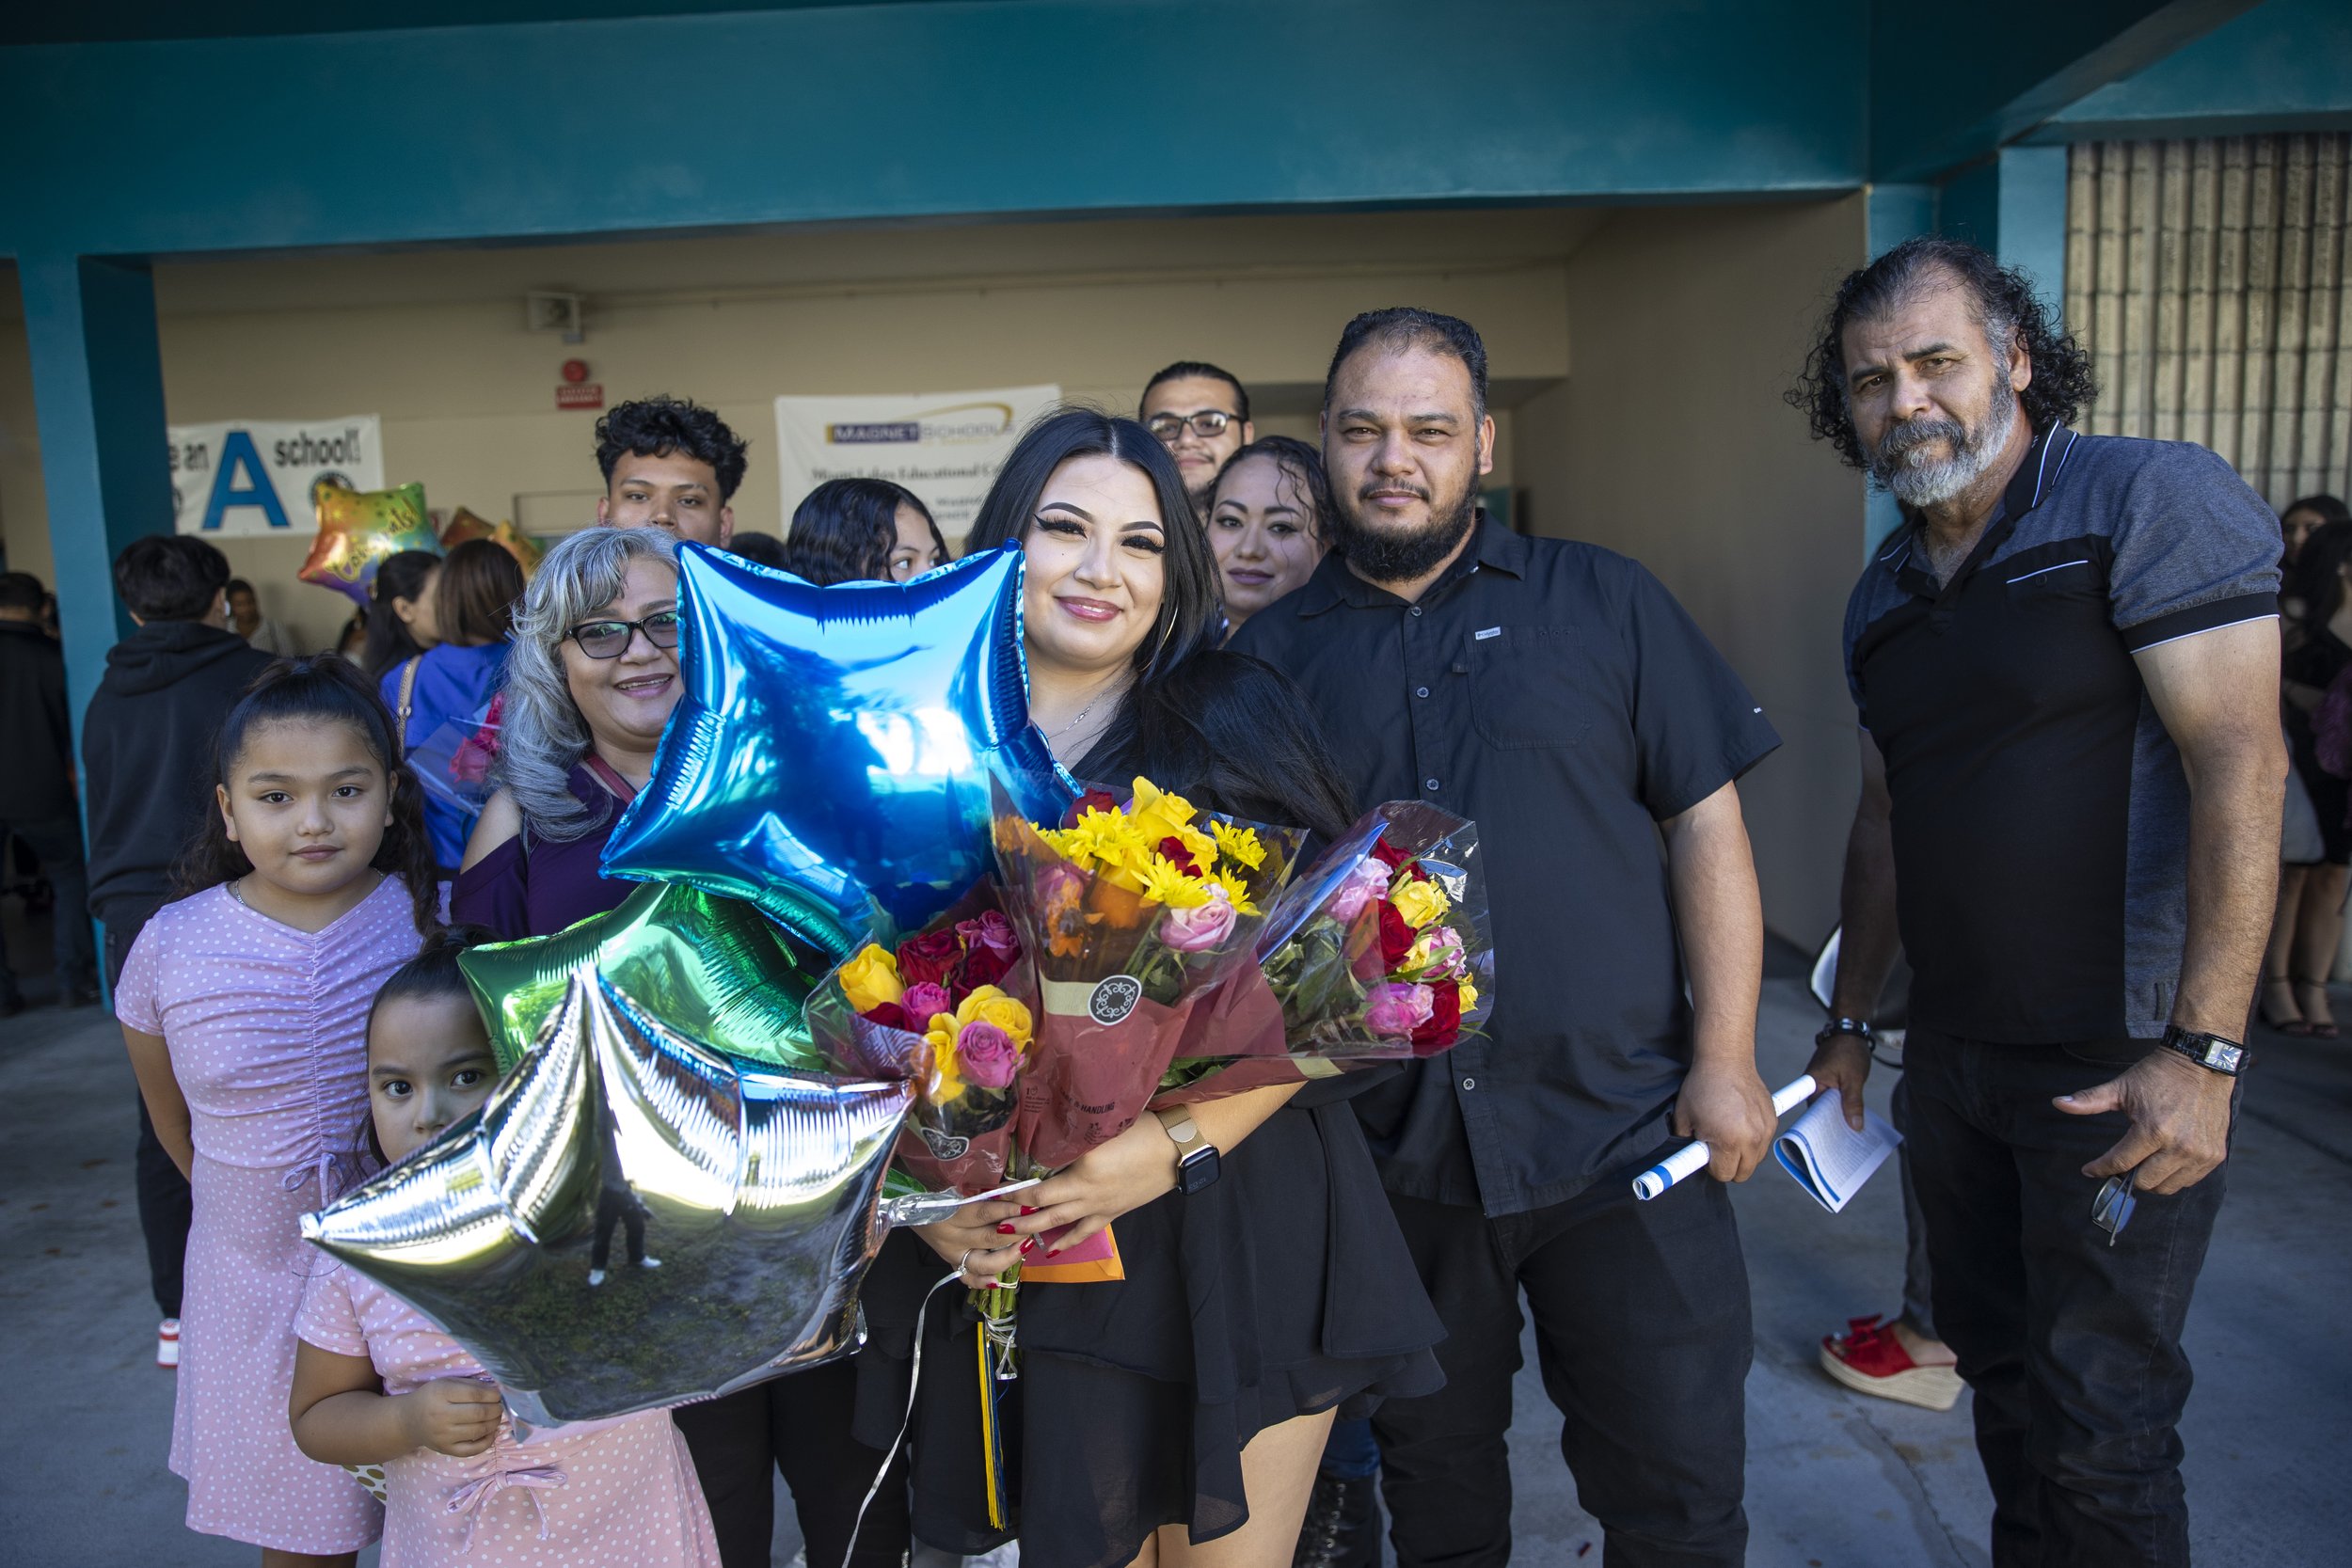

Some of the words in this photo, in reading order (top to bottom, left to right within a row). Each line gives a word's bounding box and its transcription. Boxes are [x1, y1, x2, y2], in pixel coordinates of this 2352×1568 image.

[834, 425, 917, 440] MAGNET
[184, 443, 209, 469] an
[201, 430, 290, 529] A
[274, 427, 360, 467] school!
[1081, 1101, 1116, 1115] HANDLING
